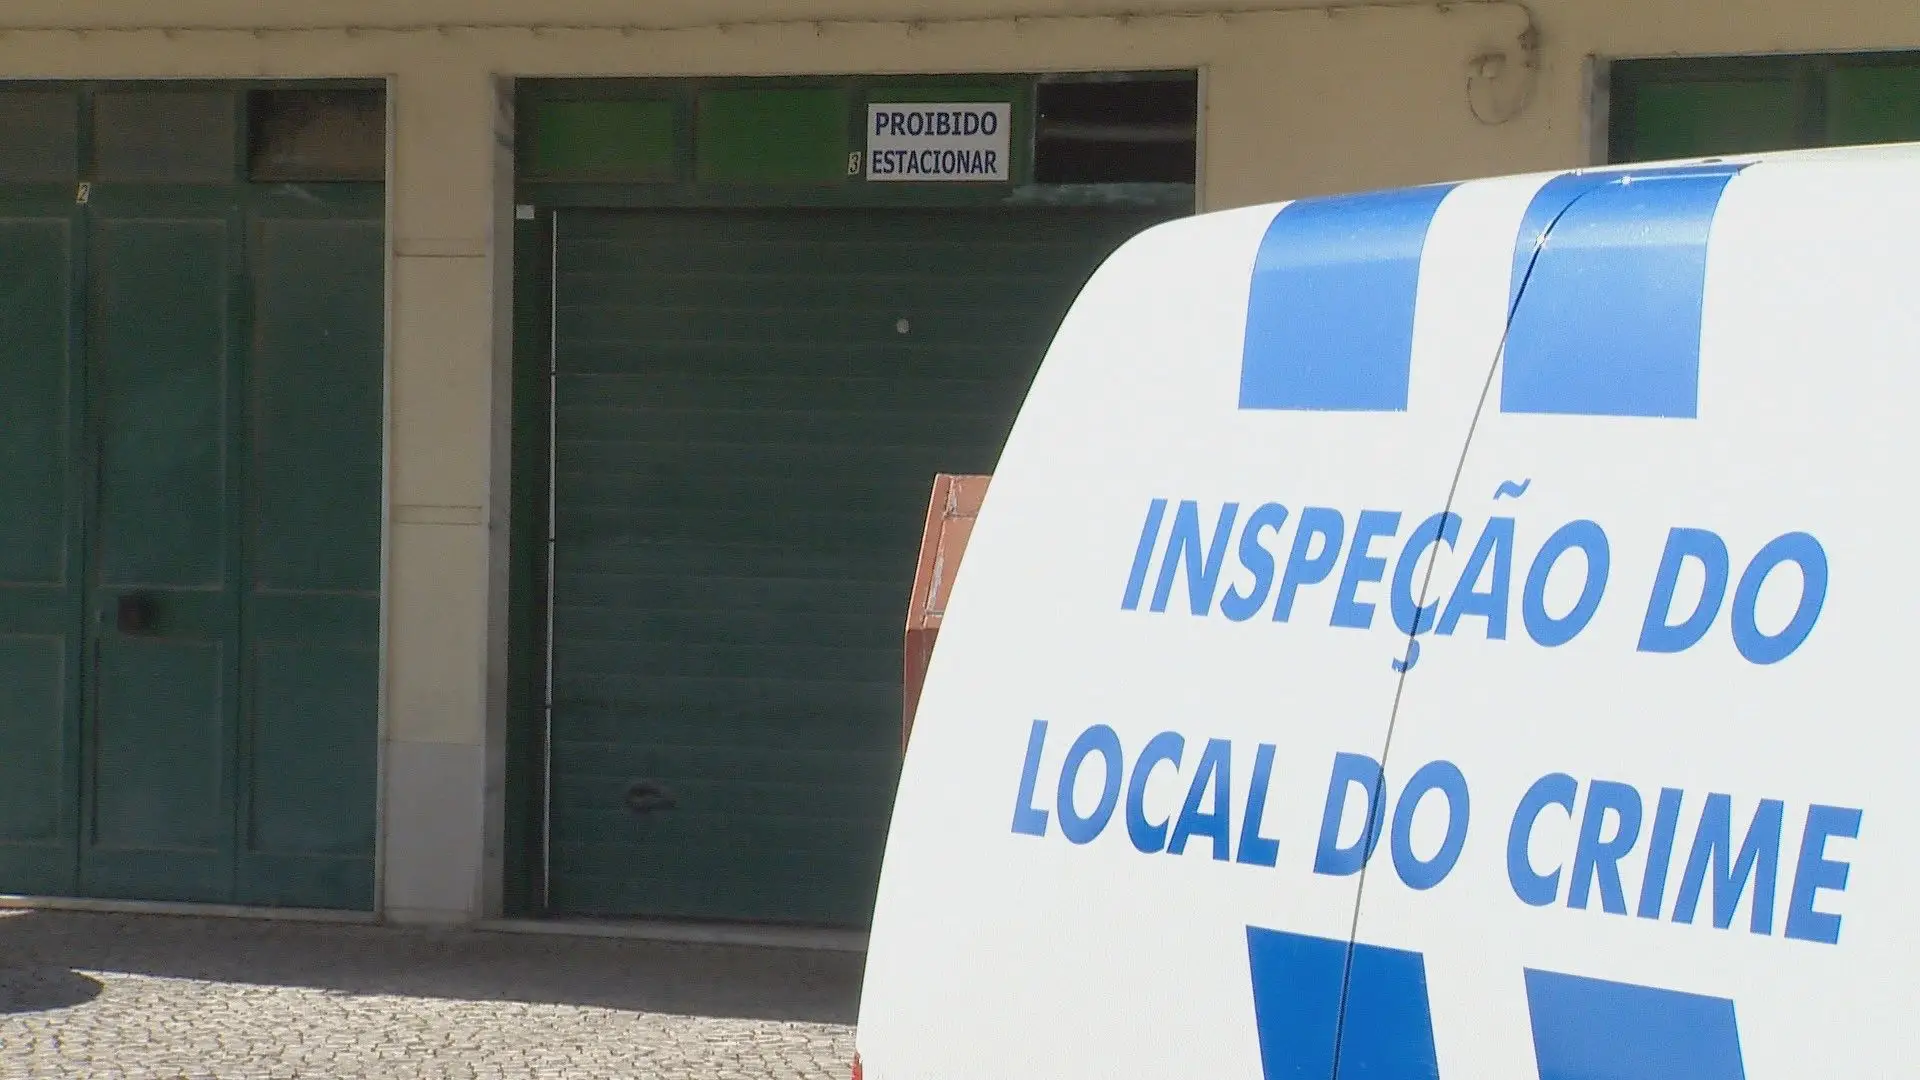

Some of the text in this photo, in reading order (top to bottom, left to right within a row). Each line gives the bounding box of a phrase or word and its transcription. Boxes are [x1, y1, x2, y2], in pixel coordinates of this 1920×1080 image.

[875, 111, 998, 136] PROIBIDO
[849, 153, 860, 174] 3
[872, 150, 998, 174] ESTACIONAR
[1122, 479, 1830, 673] INSPEÇÃO DO
[1011, 719, 1865, 945] LOCAL DO CRIME
